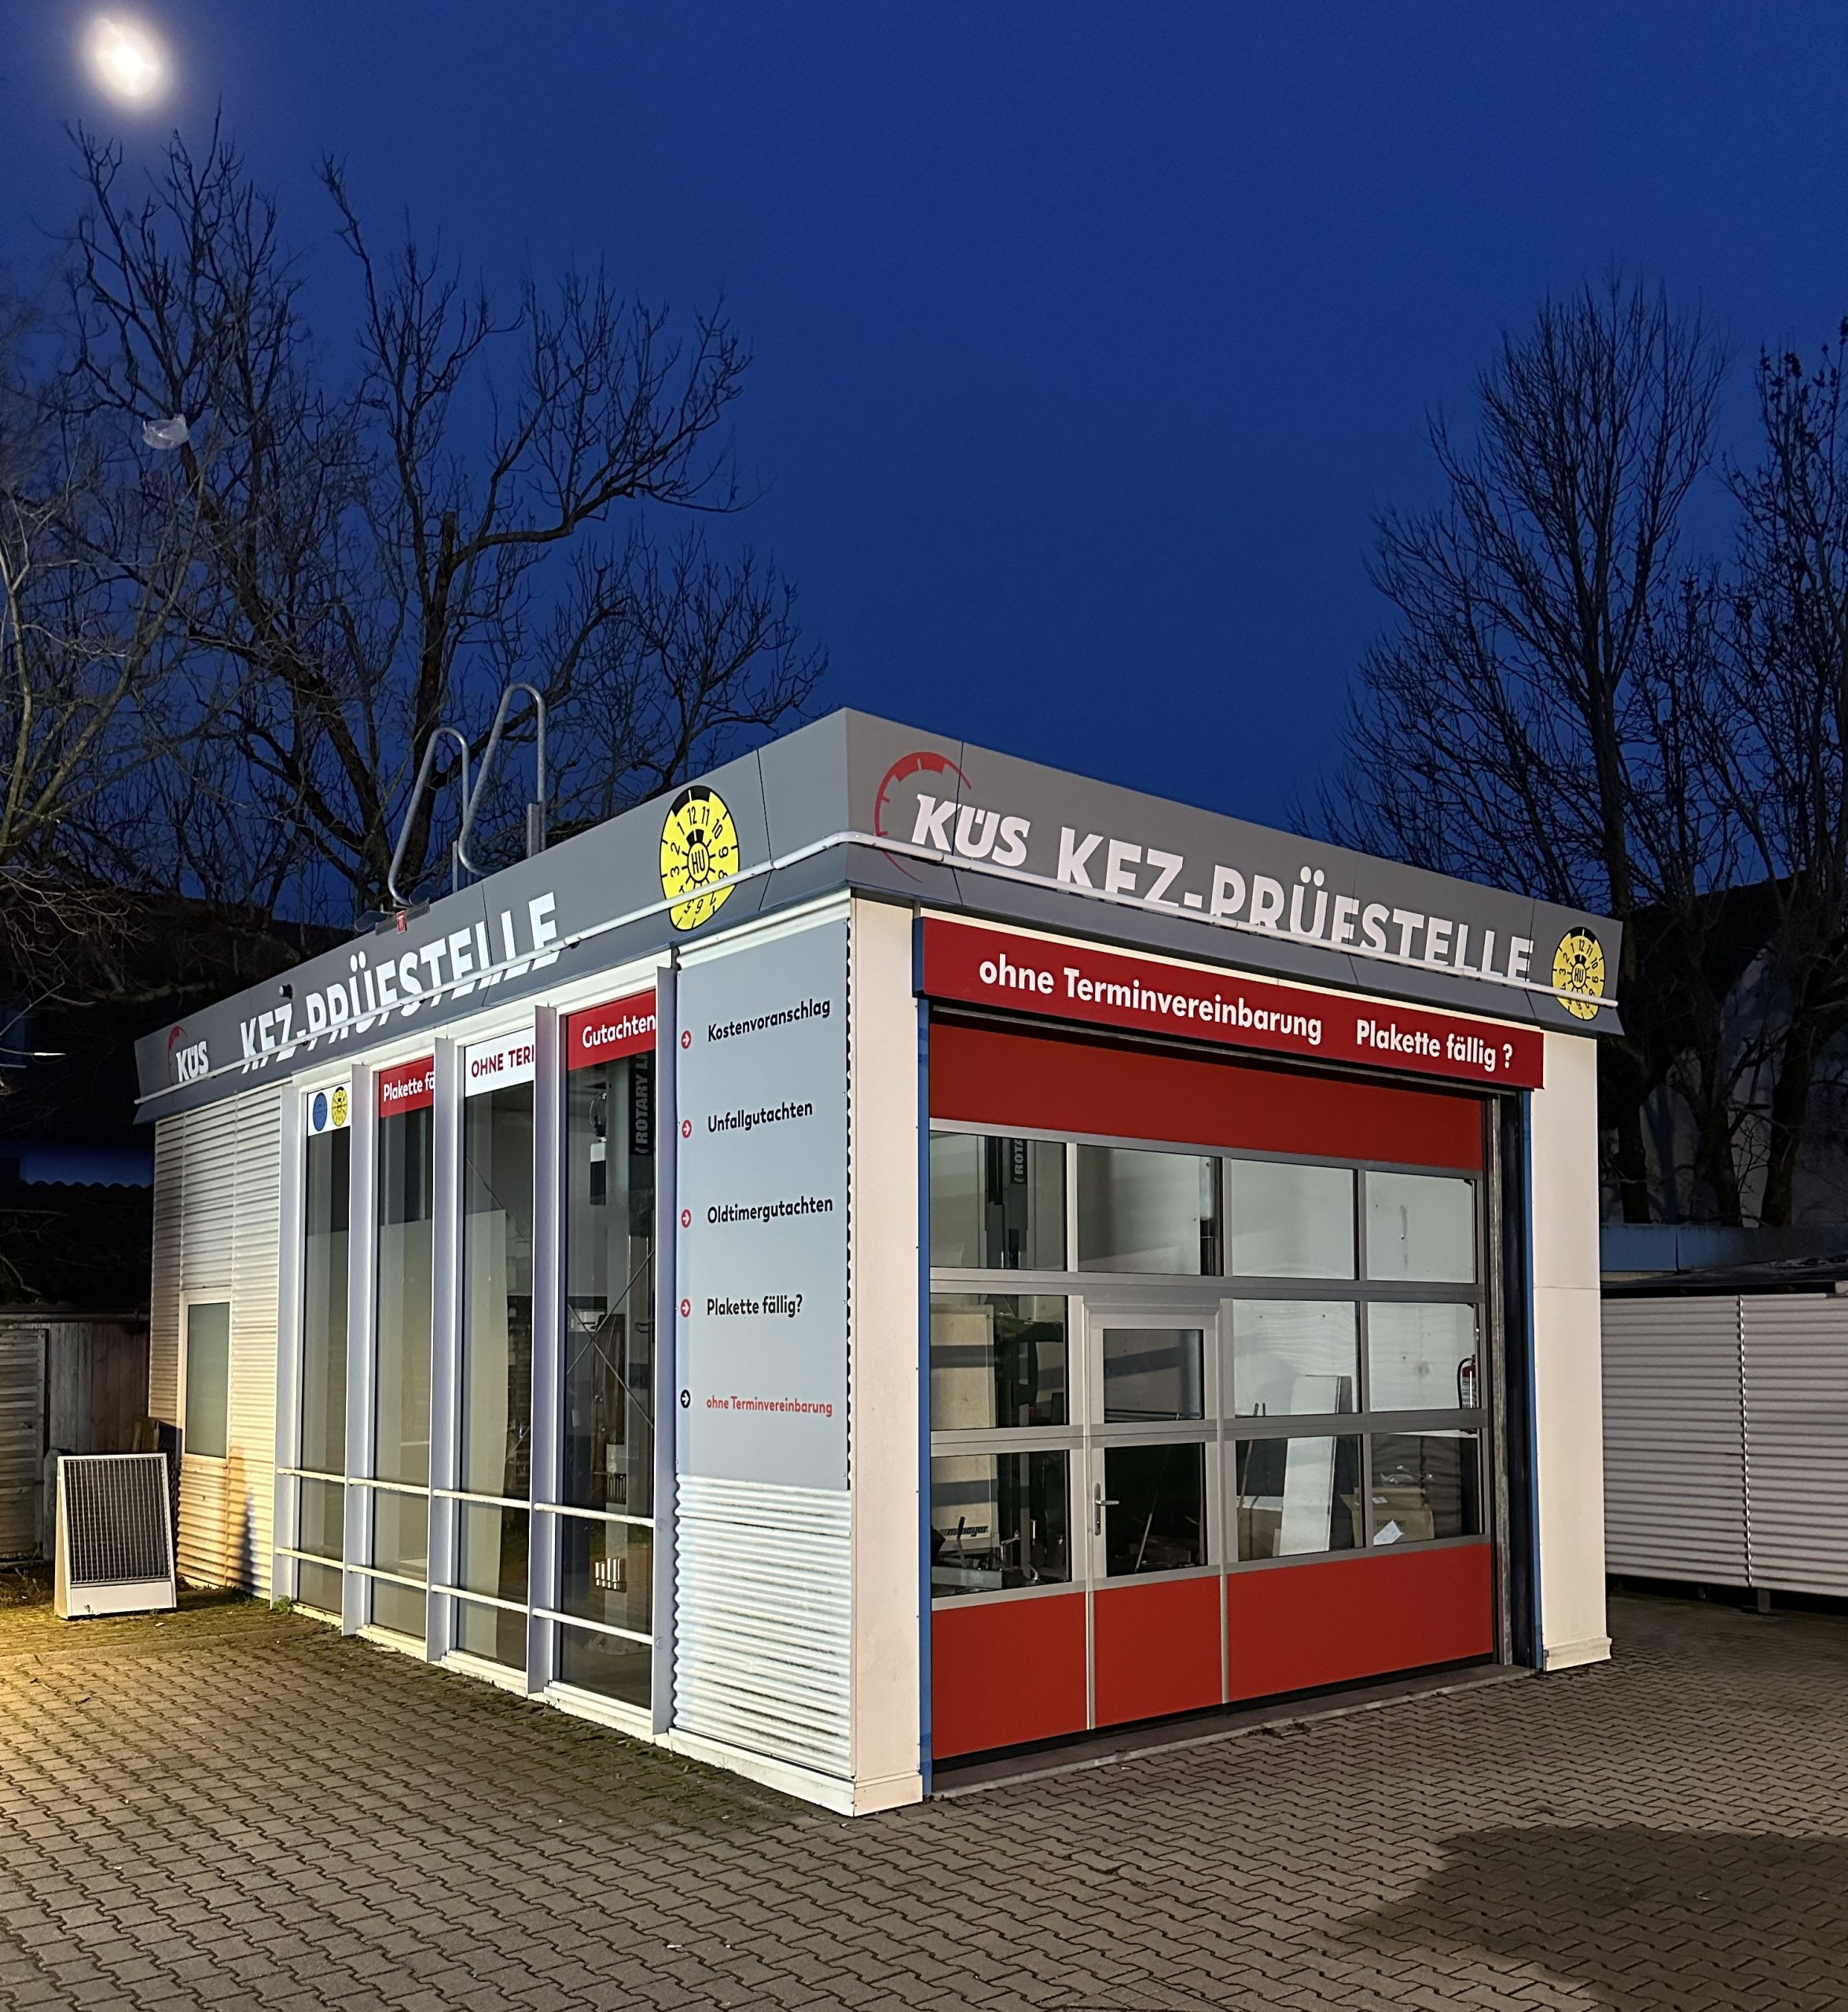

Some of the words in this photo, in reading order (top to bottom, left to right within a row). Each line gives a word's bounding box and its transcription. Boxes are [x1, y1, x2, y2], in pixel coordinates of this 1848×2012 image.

[687, 806, 697, 825] 12
[702, 806, 710, 827] 11
[712, 819, 723, 839] 10
[670, 842, 681, 855] 2
[670, 865, 680, 878] 3
[691, 849, 706, 875] HU
[911, 794, 1031, 867] KÜS
[1057, 826, 1534, 982] KFZ-PRÜFSTELLE
[1578, 939, 1585, 952] 12
[175, 1041, 209, 1082] KÜS
[240, 891, 560, 1074] KFZ-PRÜFSTELLE
[1574, 967, 1584, 983] HU
[979, 953, 1054, 994] ohne
[1064, 967, 1322, 1045] Terminvereinbarung
[582, 1015, 656, 1048] Gutachten
[707, 998, 831, 1042] Kostenvoranschlag
[1357, 1019, 1441, 1058] Plakette
[1447, 1034, 1496, 1072] fällig
[471, 1052, 504, 1078] OHNE
[509, 1045, 534, 1068] TER
[383, 1077, 423, 1102] Plakette
[634, 1073, 648, 1144] ROTARY
[707, 1101, 814, 1133] Unfallgutachten
[707, 1196, 833, 1224] Oldtimergutachten
[707, 1298, 759, 1316] Plakette
[762, 1294, 803, 1318] fällig?
[707, 1397, 729, 1410] ohne
[731, 1396, 833, 1418] Terminvereinbarung
